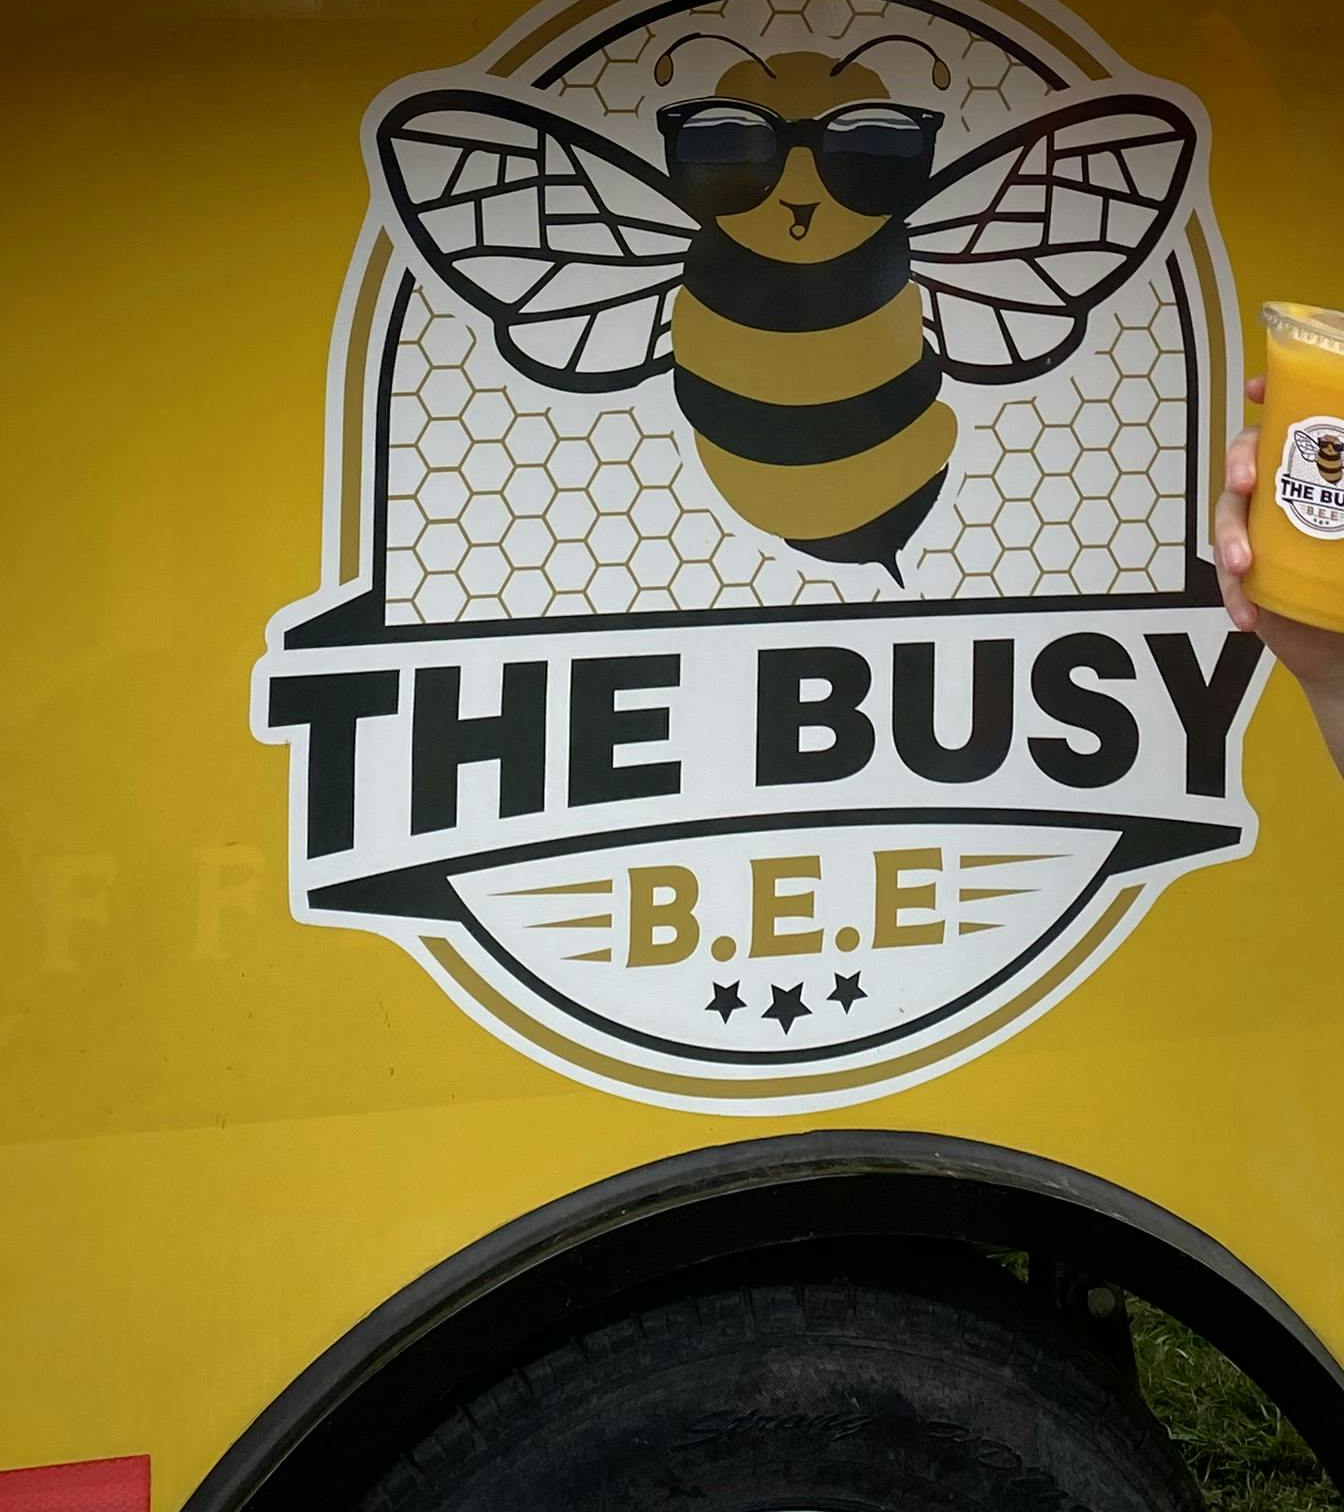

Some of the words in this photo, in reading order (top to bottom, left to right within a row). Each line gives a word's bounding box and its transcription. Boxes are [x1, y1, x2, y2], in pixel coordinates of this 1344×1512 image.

[1280, 477, 1314, 500] THE
[269, 653, 682, 860] THE
[755, 630, 1268, 799] BUSY
[625, 846, 947, 970] B.E.E
